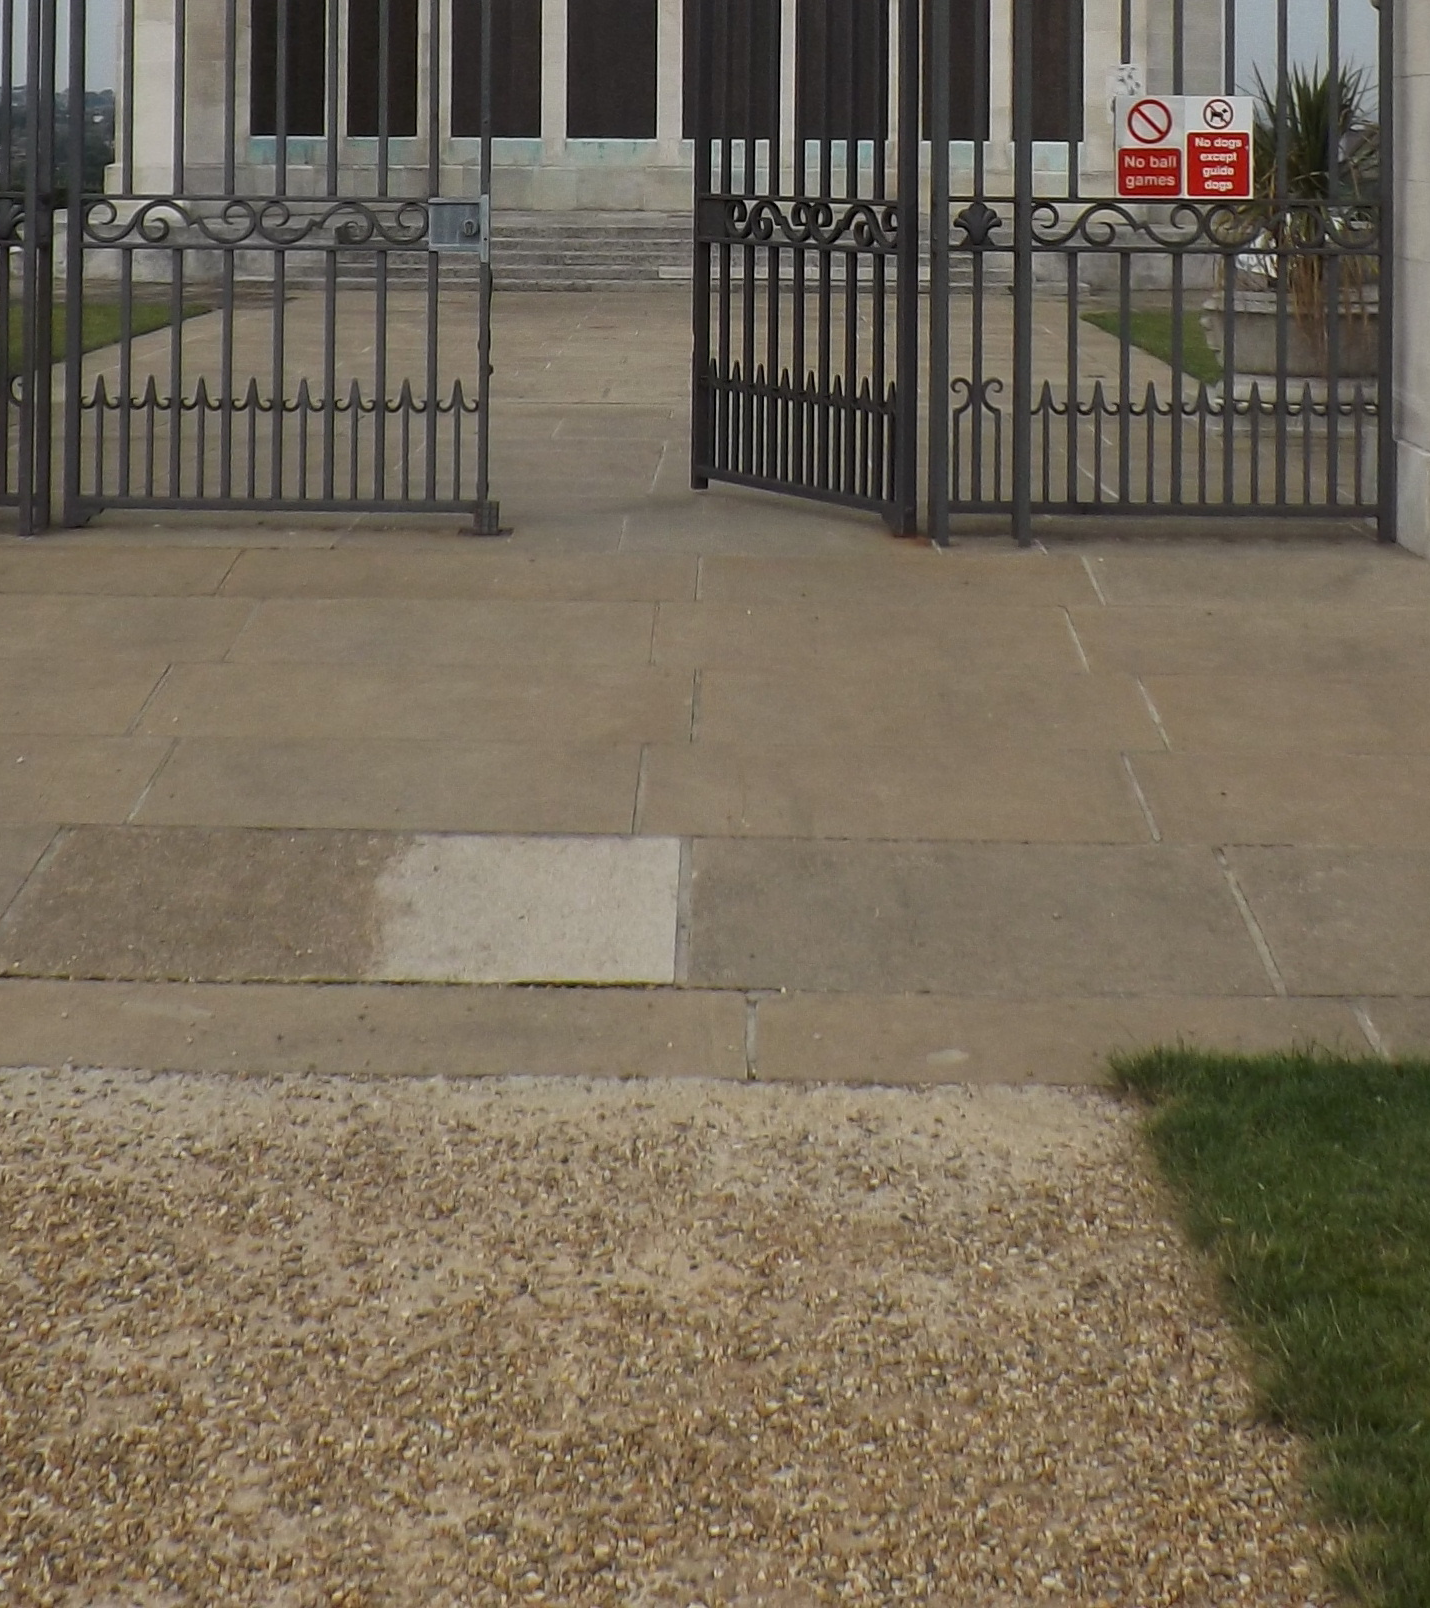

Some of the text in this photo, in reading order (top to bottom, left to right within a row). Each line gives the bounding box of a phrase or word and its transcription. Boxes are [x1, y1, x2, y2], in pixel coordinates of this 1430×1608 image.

[1194, 137, 1242, 149] No dogs
[1124, 155, 1177, 168] No ball
[1125, 175, 1175, 189] games
